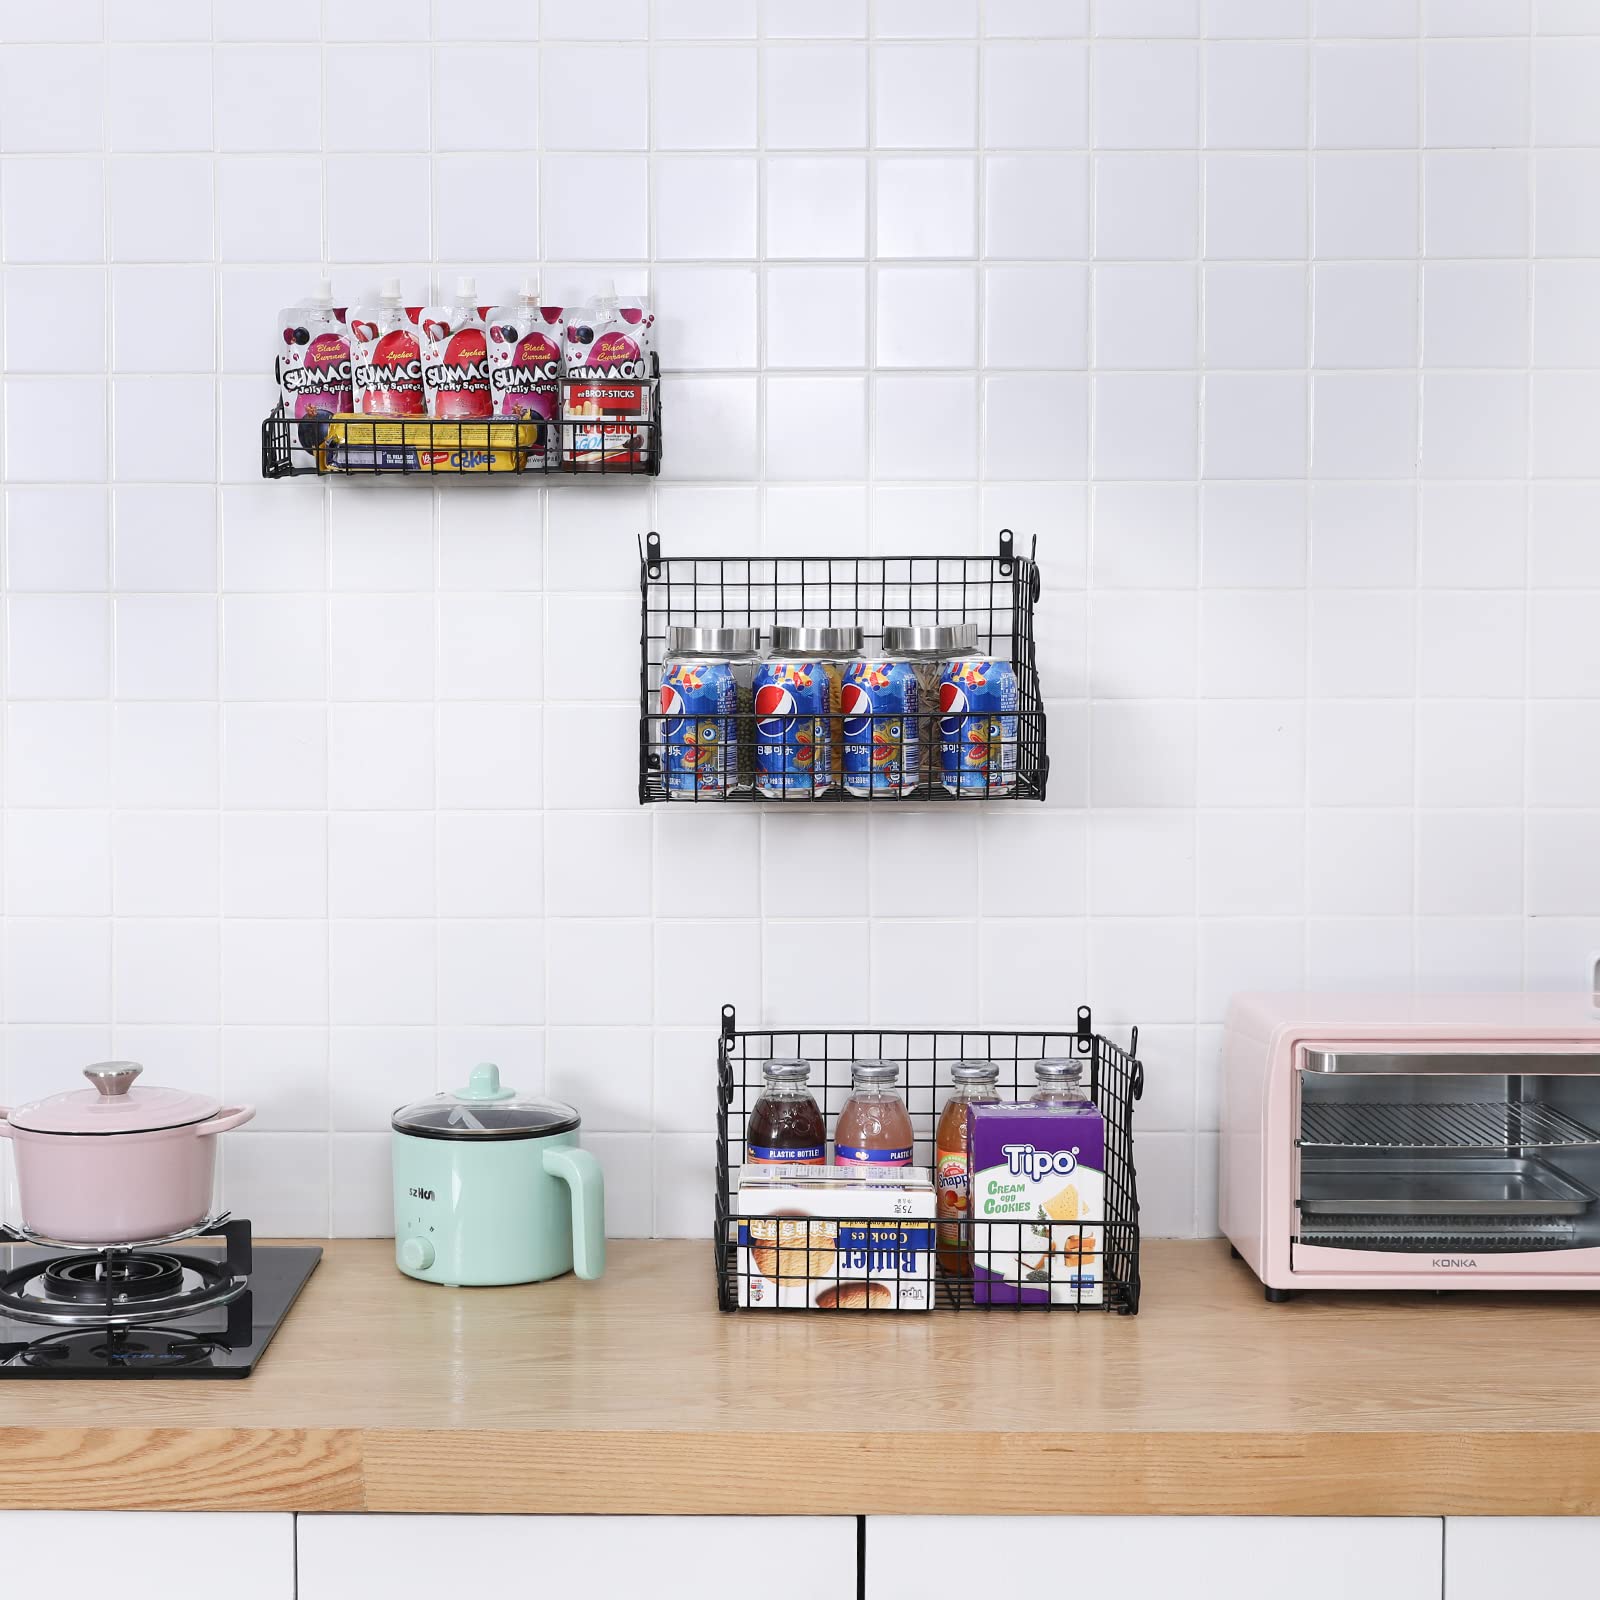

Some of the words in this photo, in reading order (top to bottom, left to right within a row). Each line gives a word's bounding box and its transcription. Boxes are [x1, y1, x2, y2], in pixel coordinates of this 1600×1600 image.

[317, 344, 341, 352] Black
[523, 343, 545, 351] Black
[602, 343, 624, 352] Black
[386, 351, 413, 361] Lychee
[458, 348, 486, 358] Lychee
[522, 352, 551, 361] Currant
[597, 352, 629, 362] Currant
[585, 390, 635, 398] BROT-STICKS
[769, 1150, 795, 1158] PLASTIC
[1003, 1144, 1076, 1183] Tipo
[987, 1180, 1026, 1195] CREAM
[983, 1198, 1031, 1215] COOKIES
[851, 1232, 908, 1244] Cookes
[1432, 1259, 1477, 1268] KONKA
